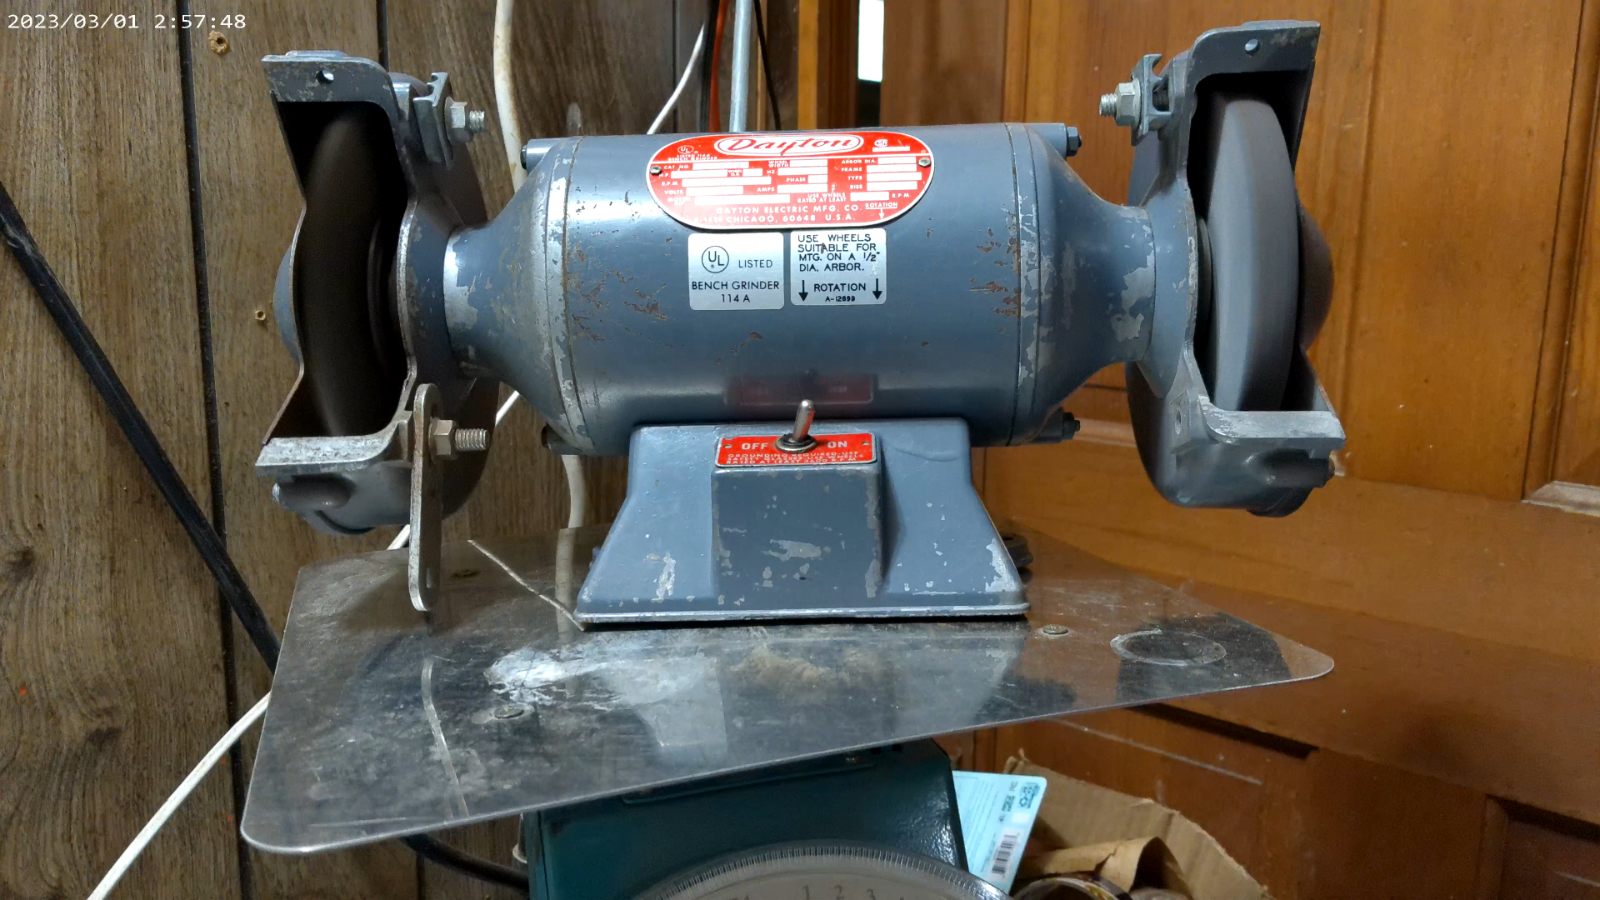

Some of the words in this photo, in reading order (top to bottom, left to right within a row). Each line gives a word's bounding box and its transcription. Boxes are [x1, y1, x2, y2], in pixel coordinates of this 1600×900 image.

[727, 138, 852, 155] Dayton
[716, 206, 759, 214] DAYTON
[764, 205, 808, 213] ELECTRIC
[813, 204, 839, 213] MFG.
[844, 203, 862, 212] CO.
[726, 215, 778, 224] CHICAGO,
[782, 213, 816, 222] 60648
[825, 212, 856, 221] U.S.A.
[797, 234, 819, 243] USE
[827, 233, 871, 242] WHEELS
[797, 243, 849, 253] SUITABLE
[856, 243, 877, 252] FOR
[799, 252, 822, 262] MTG.
[827, 252, 842, 261] ON
[848, 252, 856, 261] A
[738, 259, 773, 269] LISTED
[799, 262, 819, 272] DIA.
[824, 262, 865, 272] ARBOR.
[691, 281, 728, 290] BENCH
[731, 280, 780, 290] GRINDER
[813, 283, 867, 292] ROTATION
[721, 293, 740, 303] 114
[742, 293, 751, 303] A
[741, 442, 769, 450] OFF
[827, 440, 847, 449] ON
[802, 885, 810, 900] 1
[834, 884, 845, 900] 2
